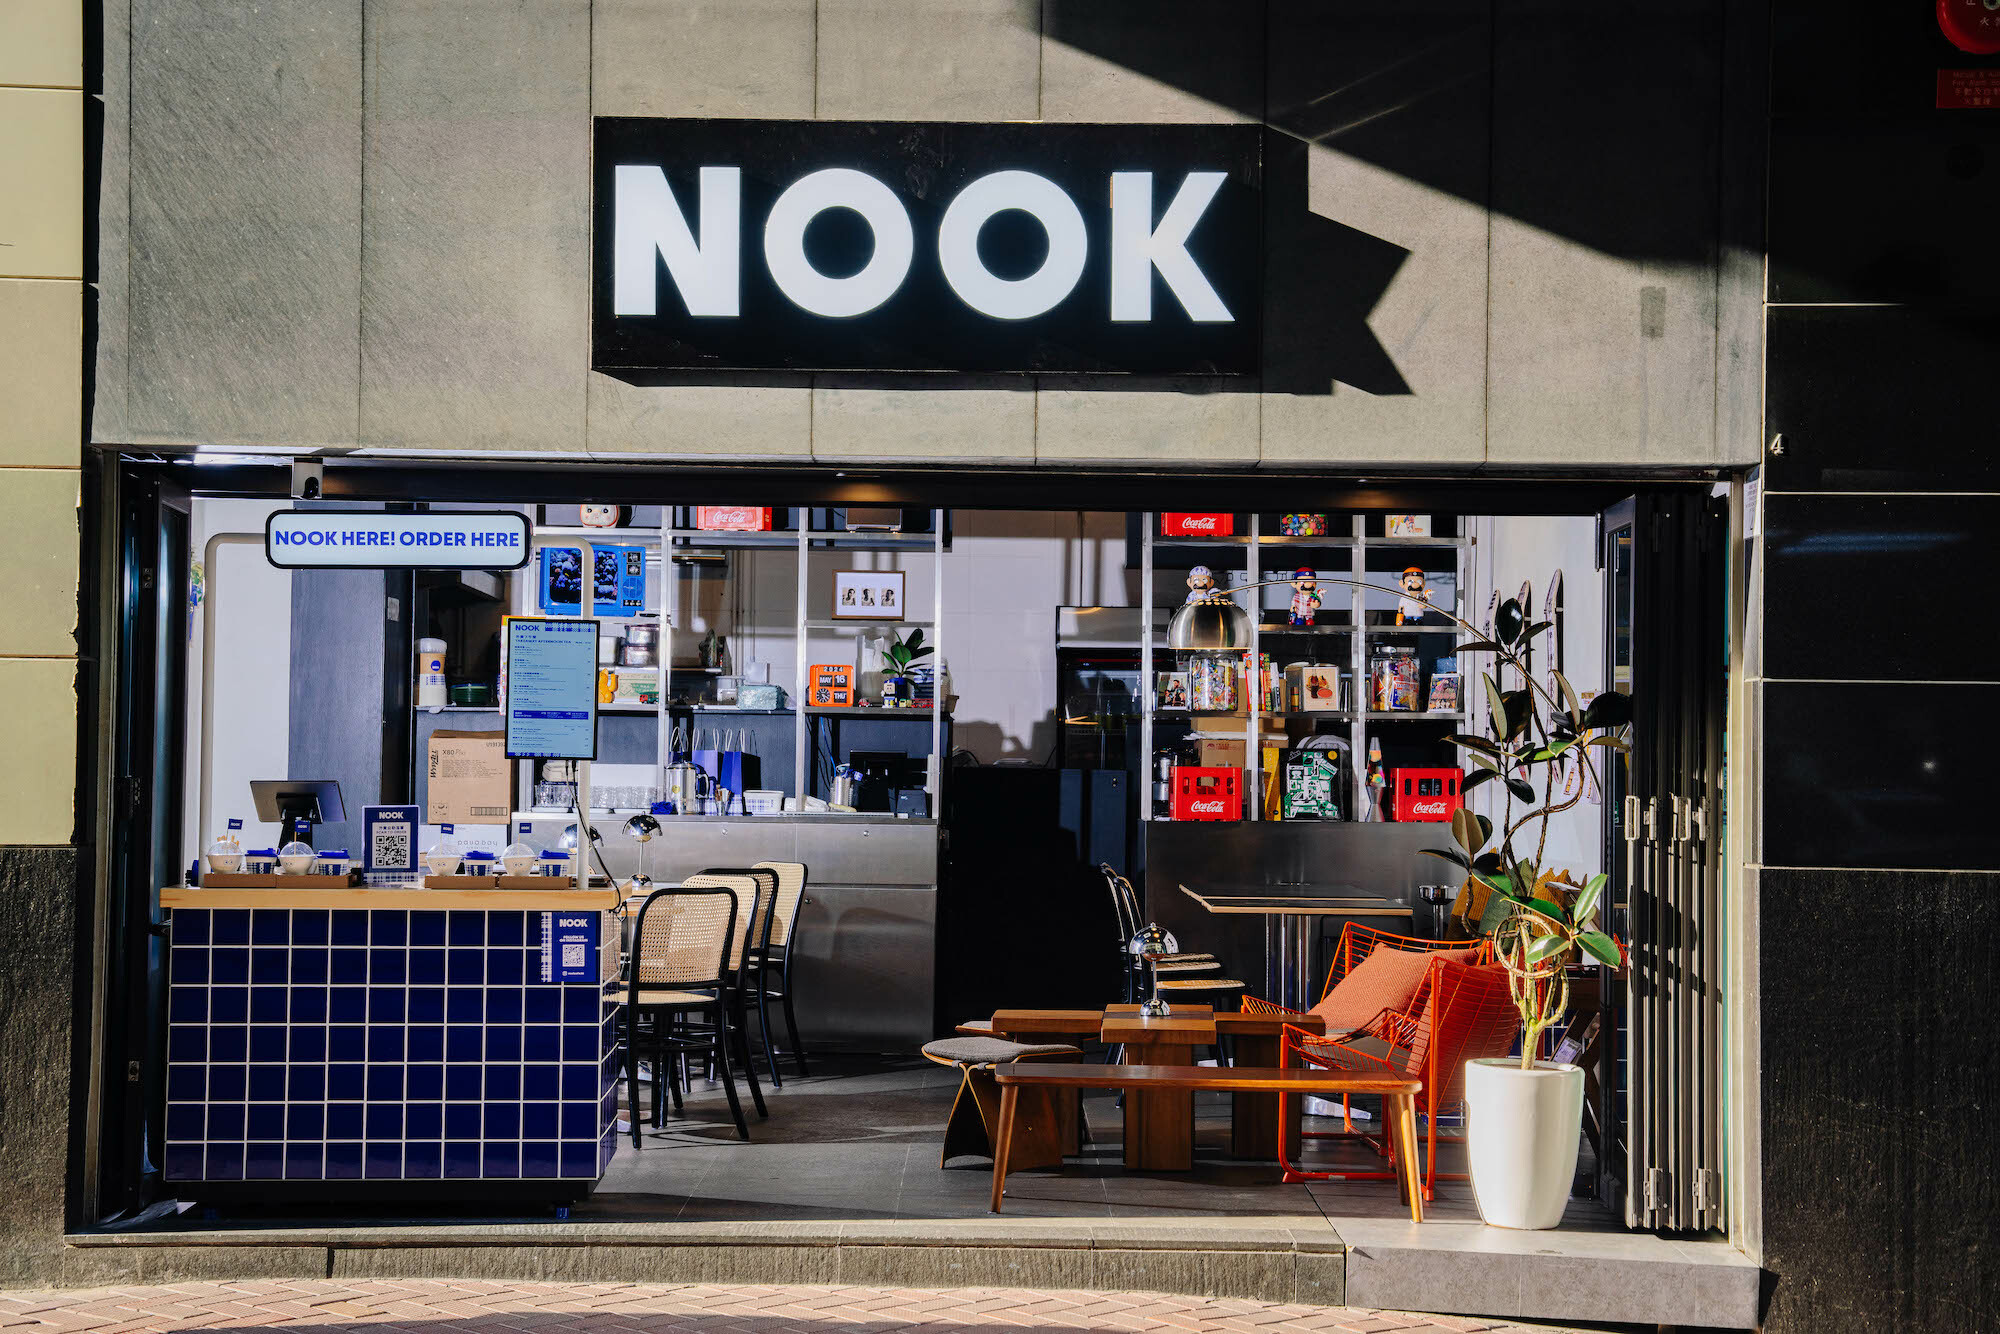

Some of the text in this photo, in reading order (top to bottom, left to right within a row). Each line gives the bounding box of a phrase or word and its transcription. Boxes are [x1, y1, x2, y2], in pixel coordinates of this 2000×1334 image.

[614, 165, 1235, 321] NOOK
[1770, 433, 1784, 456] 4
[275, 531, 519, 547] NOOK HERE! ORDER HERE
[515, 624, 540, 632] NOOK
[836, 675, 845, 683] 16
[379, 811, 404, 819] NOOK
[559, 919, 588, 928] NOOK
